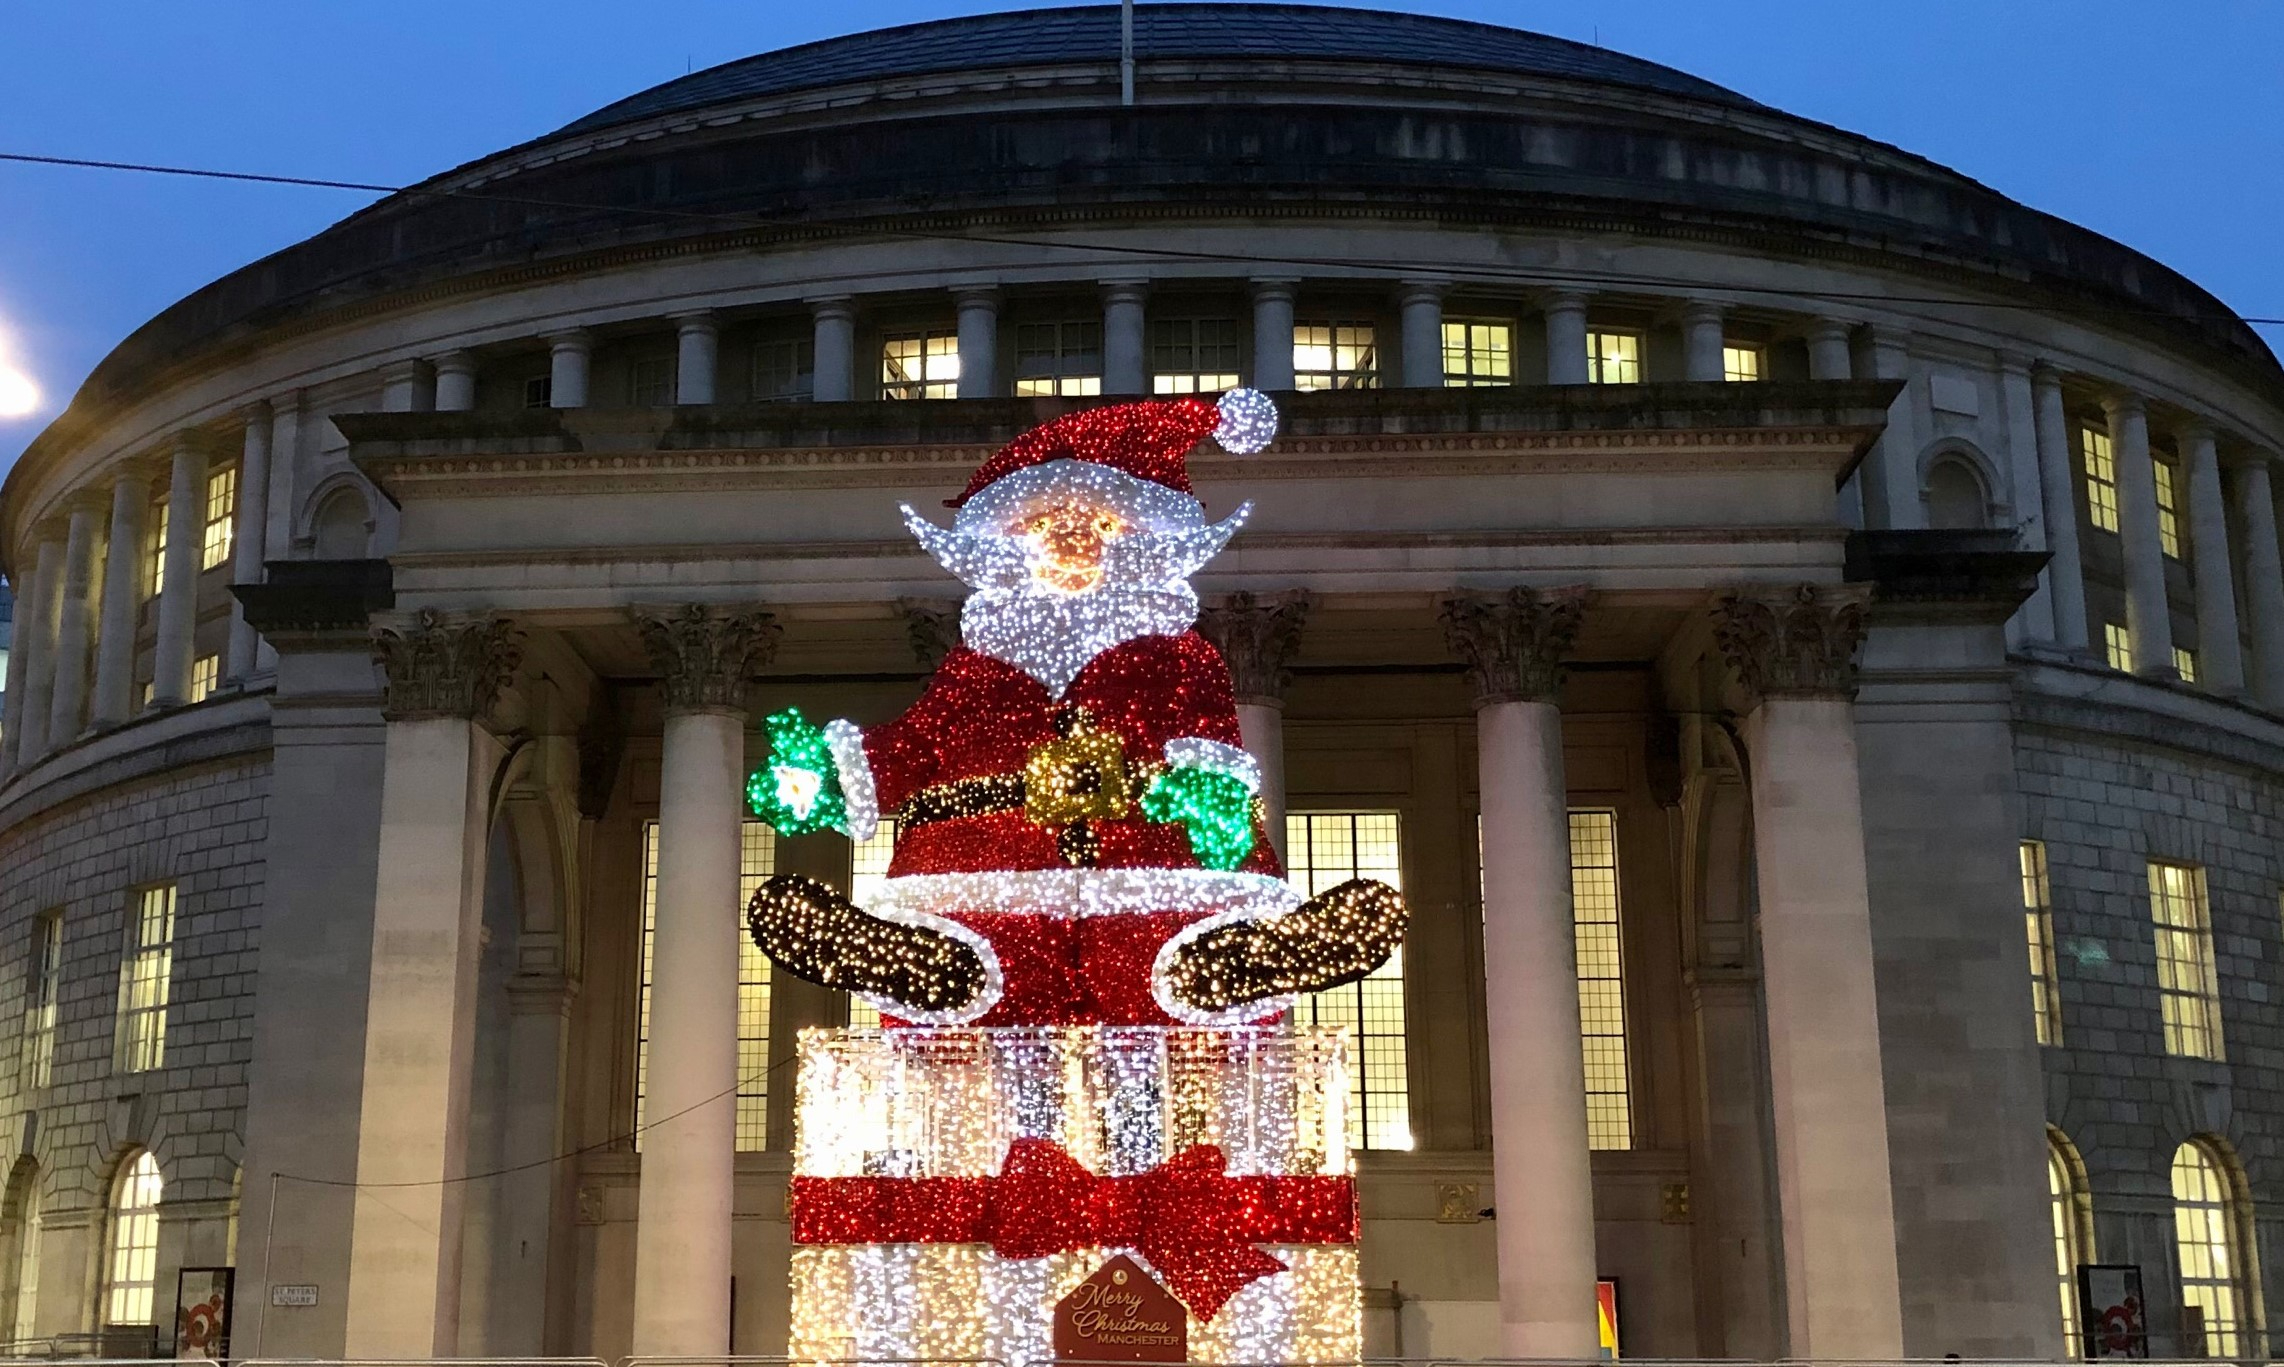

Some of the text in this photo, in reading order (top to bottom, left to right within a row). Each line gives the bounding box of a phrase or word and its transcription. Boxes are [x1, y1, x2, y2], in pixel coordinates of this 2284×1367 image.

[1071, 1282, 1144, 1317] Merry
[1072, 1309, 1171, 1338] Christmas
[1097, 1333, 1179, 1346] MANCHESTER
